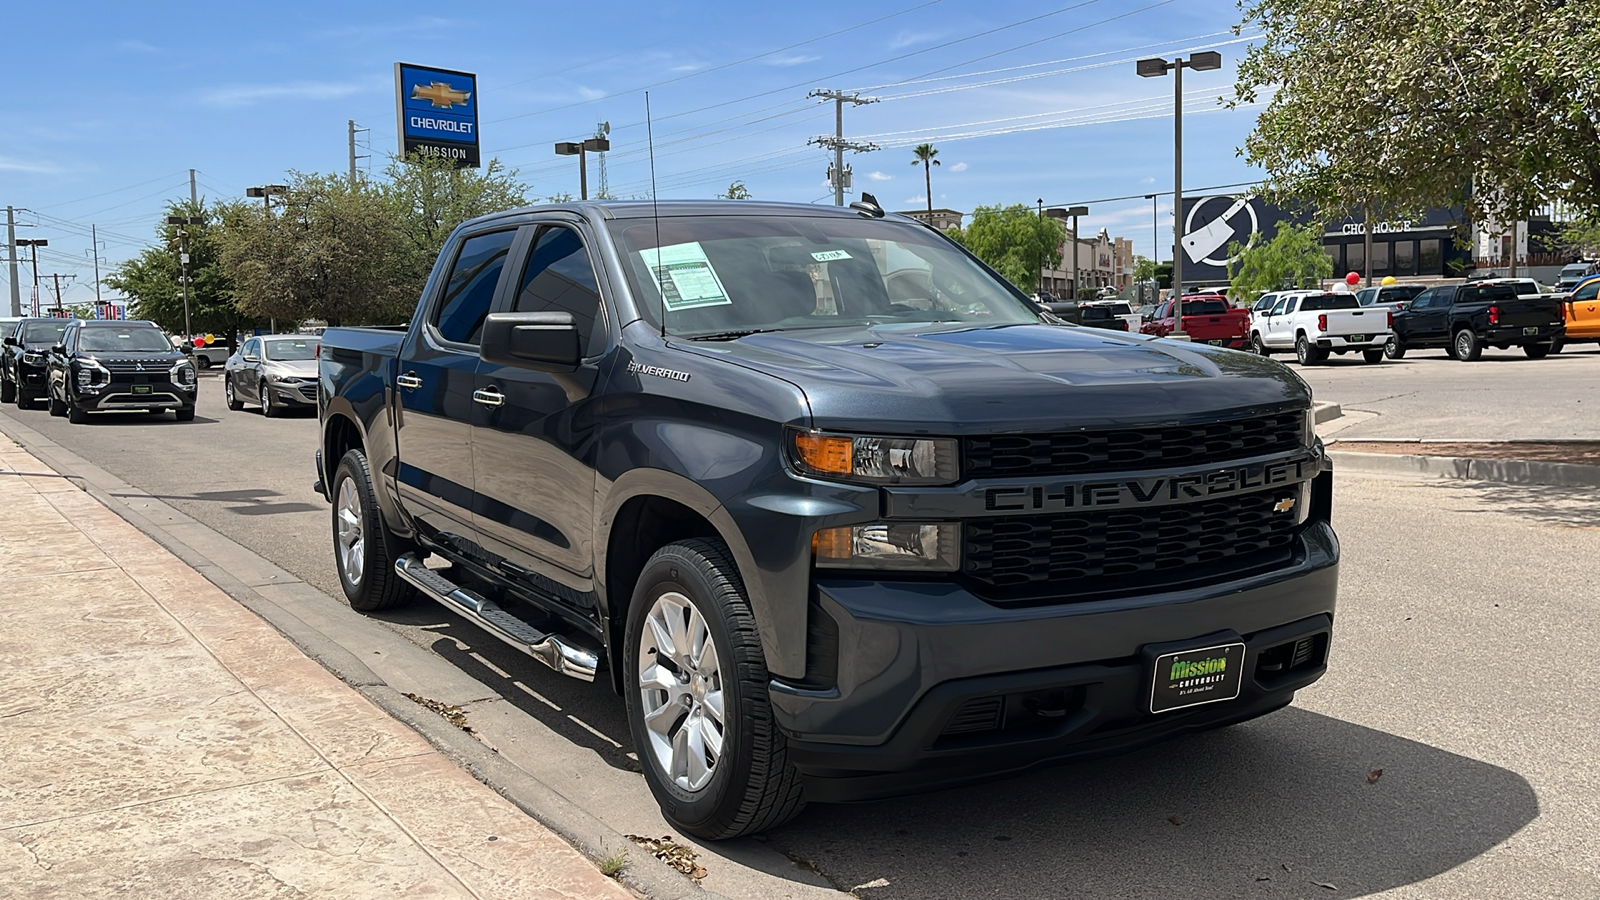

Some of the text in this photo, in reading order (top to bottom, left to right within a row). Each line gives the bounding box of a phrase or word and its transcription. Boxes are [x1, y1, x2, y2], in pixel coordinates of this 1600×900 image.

[411, 116, 473, 133] CHEVROLET
[422, 145, 466, 159] MISSION
[1342, 220, 1412, 235] CHOHOUSE
[627, 361, 690, 382] SILVERADO
[985, 457, 1307, 511] CHEVROLET
[1170, 657, 1227, 680] Mission
[1179, 674, 1225, 688] CHEVROLET
